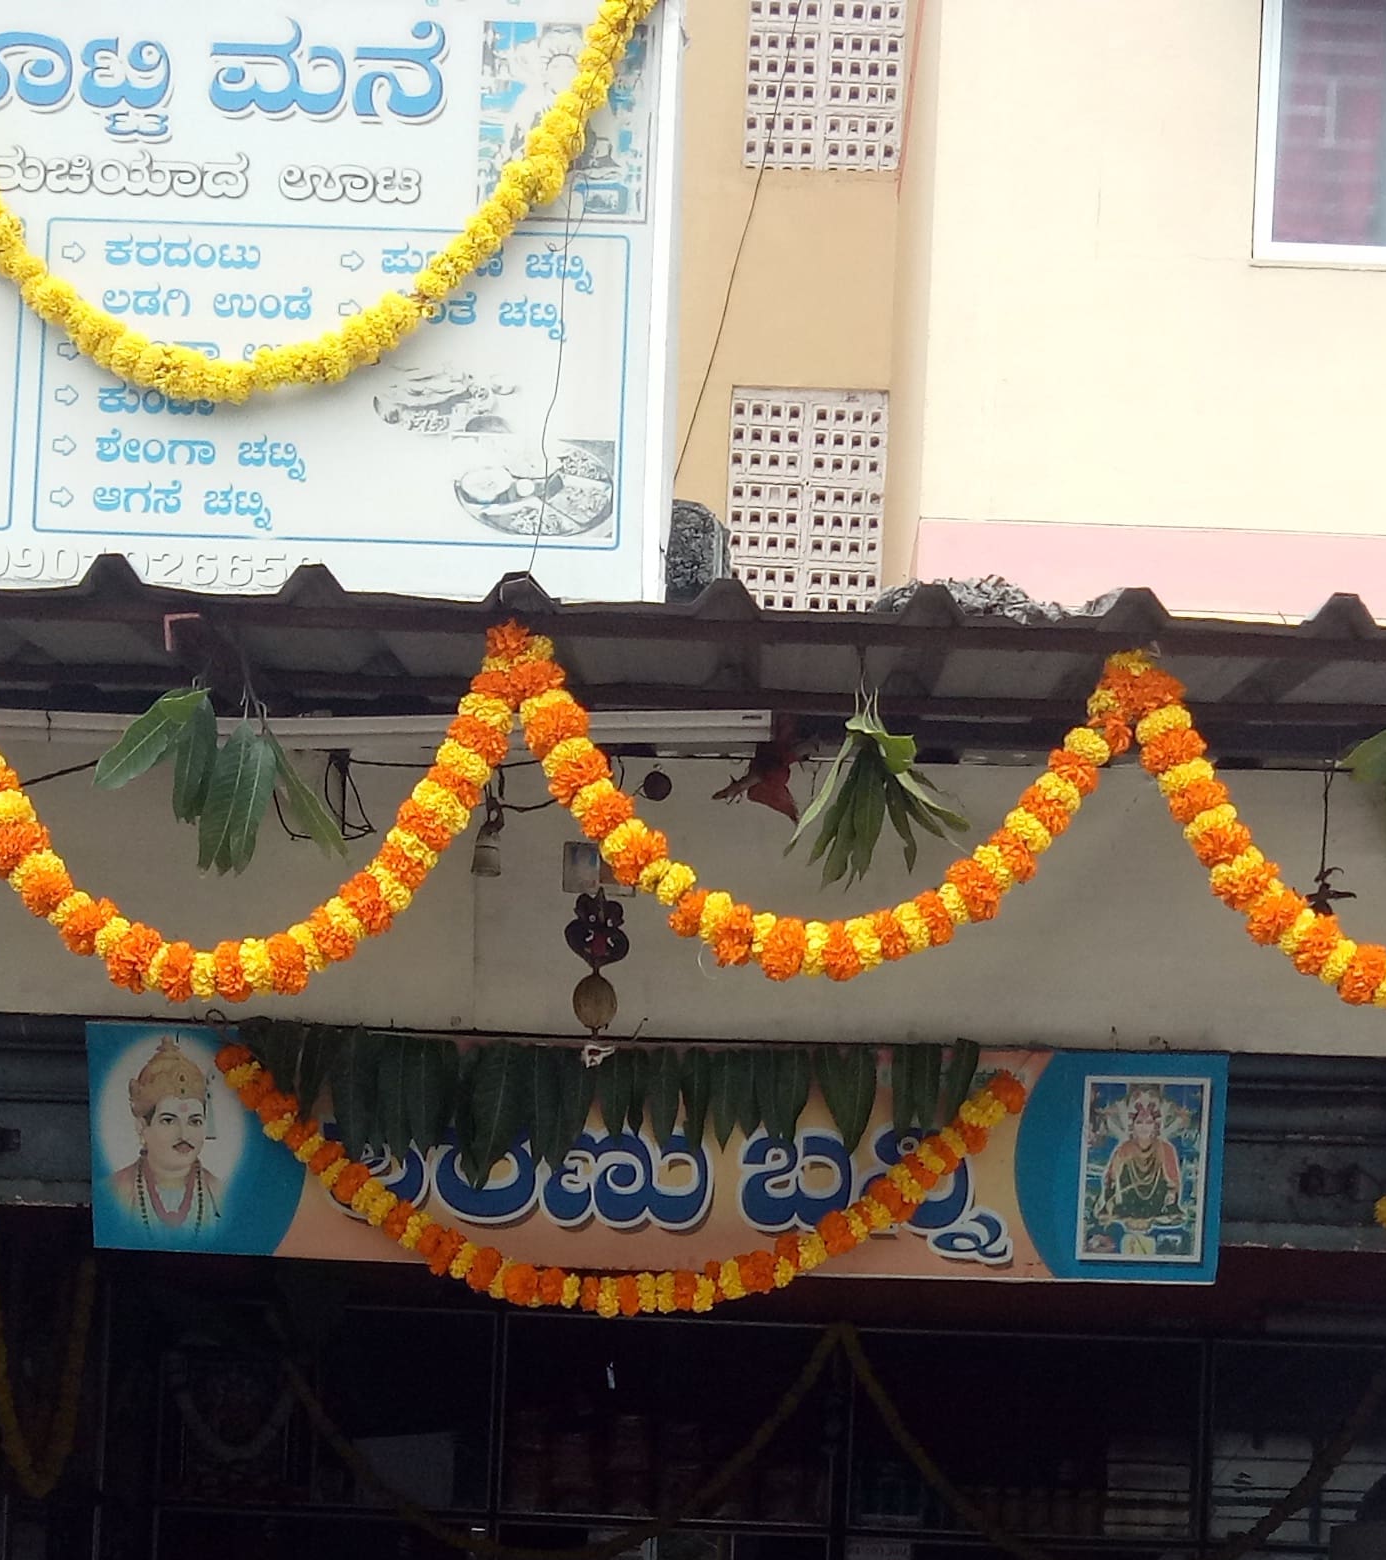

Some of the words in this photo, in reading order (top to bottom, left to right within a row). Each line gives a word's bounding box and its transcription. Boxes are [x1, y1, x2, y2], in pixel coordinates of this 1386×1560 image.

[210, 17, 447, 125] ಮನೆ
[279, 160, 422, 204] ಊಟ
[103, 233, 262, 271] ಕರದಂಟು
[526, 247, 595, 295] ಚಟ್ನಿ
[213, 285, 314, 322] ಉಂಡೆ
[498, 295, 567, 343] ಚಟ್ನಿ
[95, 428, 216, 466] ಶೇಂಗಾ
[238, 433, 307, 483] ಚಟ್ನಿ
[204, 484, 273, 531] ಚಟ್ನಿ
